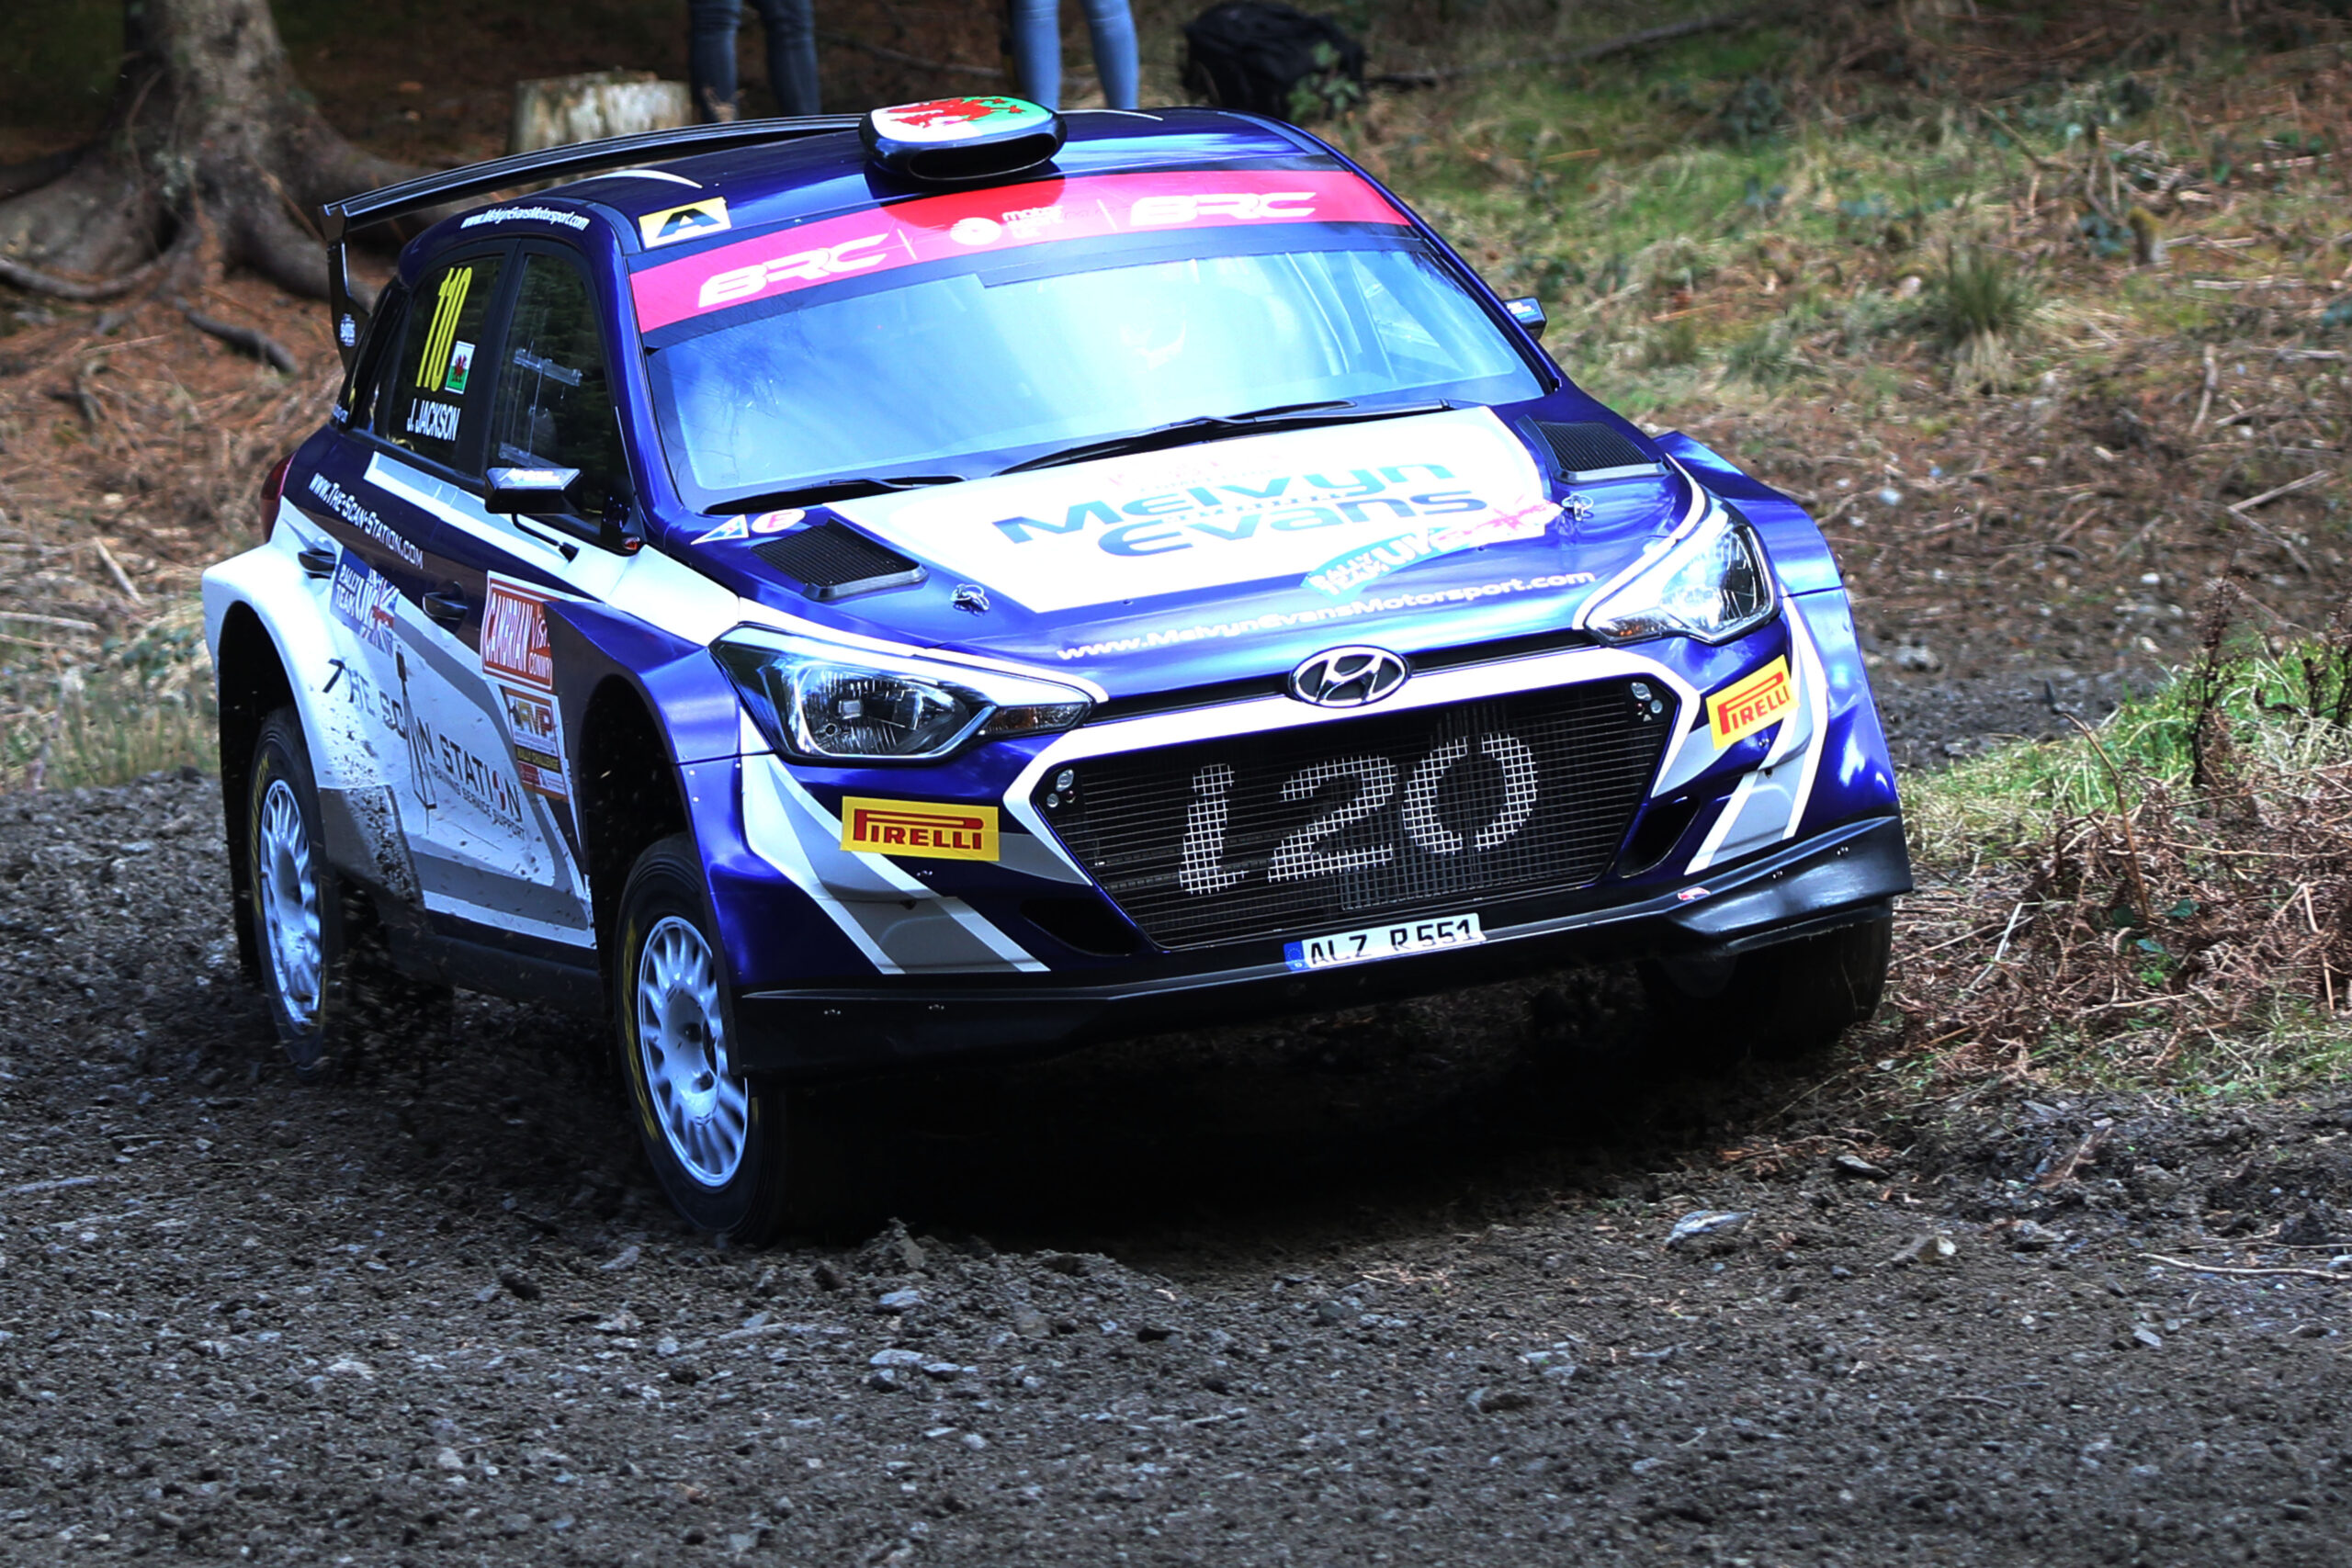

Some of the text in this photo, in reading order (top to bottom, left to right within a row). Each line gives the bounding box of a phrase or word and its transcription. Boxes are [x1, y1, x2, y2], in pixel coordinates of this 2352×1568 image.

[1130, 192, 1317, 226] BRC
[698, 233, 888, 308] BRC
[416, 266, 472, 392] 110
[415, 399, 460, 441] JACKSON
[992, 463, 1457, 544] Melvyn
[1097, 489, 1488, 557] Evans
[1716, 671, 1791, 736] PIRELLI
[853, 808, 984, 850] PIRELLI
